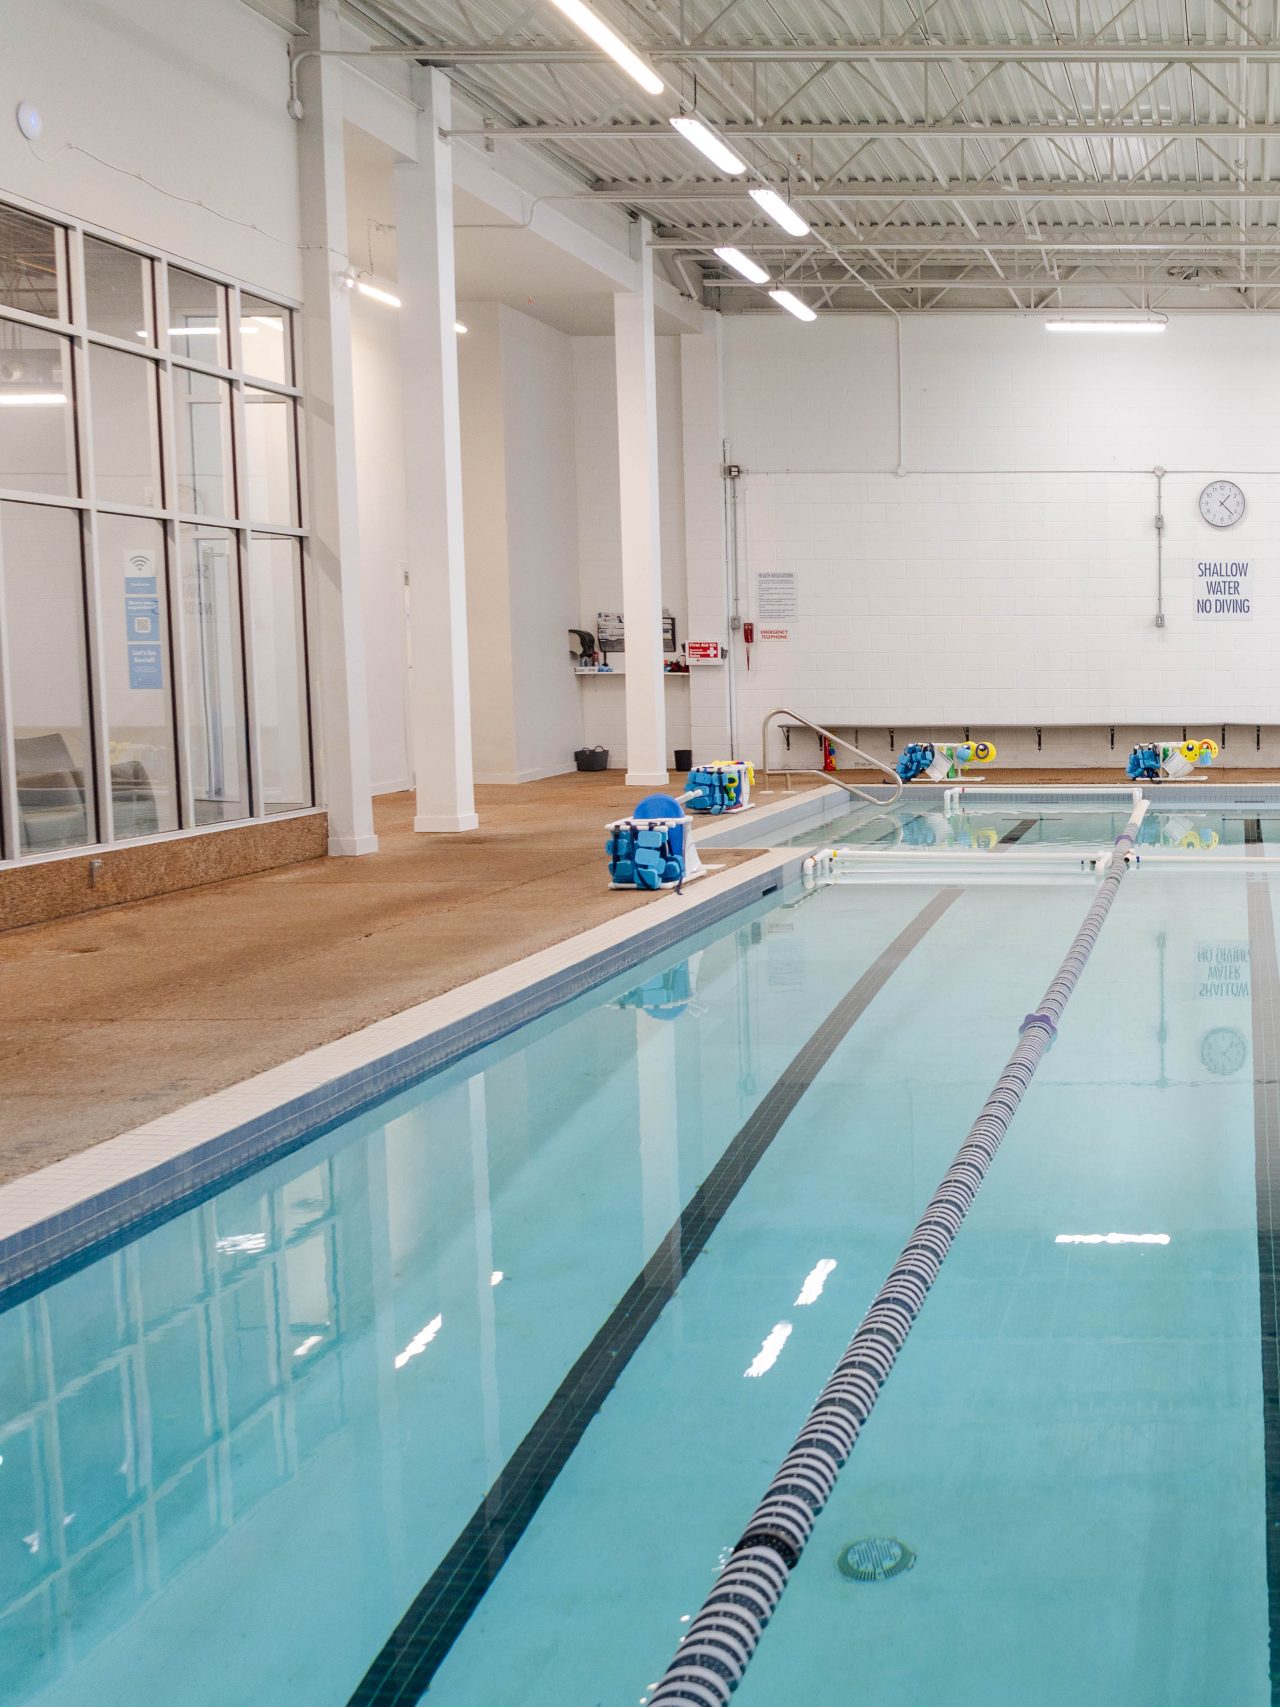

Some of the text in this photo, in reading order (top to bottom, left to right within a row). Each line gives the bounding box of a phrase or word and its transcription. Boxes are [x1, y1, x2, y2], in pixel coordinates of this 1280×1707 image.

[1198, 562, 1249, 578] SHALLOW
[1206, 580, 1240, 596] WATER
[1197, 599, 1250, 613] NO DIVING
